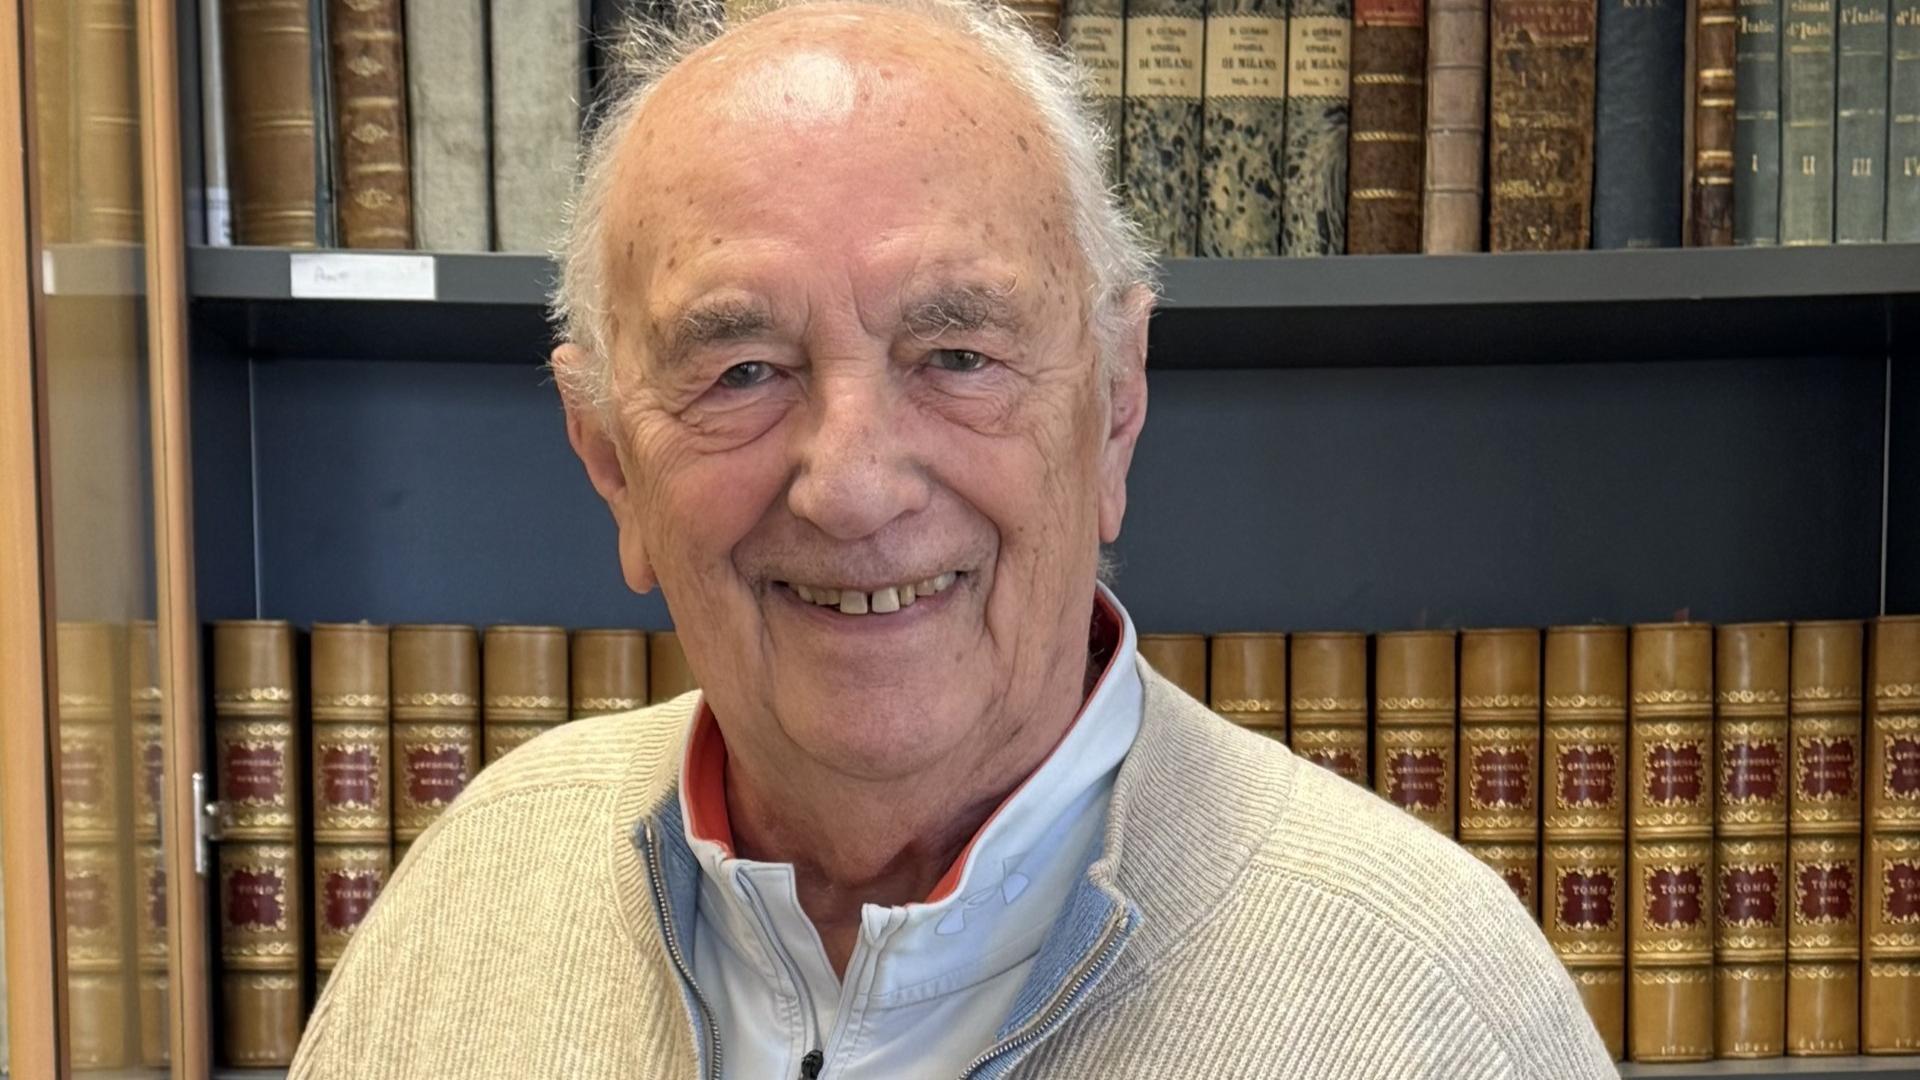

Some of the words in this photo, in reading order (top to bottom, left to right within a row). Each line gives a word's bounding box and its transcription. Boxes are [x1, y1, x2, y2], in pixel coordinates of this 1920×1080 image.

[1803, 155, 1815, 176] II
[1852, 157, 1871, 177] III
[1572, 884, 1607, 896] TOMO
[1660, 883, 1696, 895] TOMO
[1735, 882, 1771, 894] TOMO
[1811, 878, 1847, 890] TOMO
